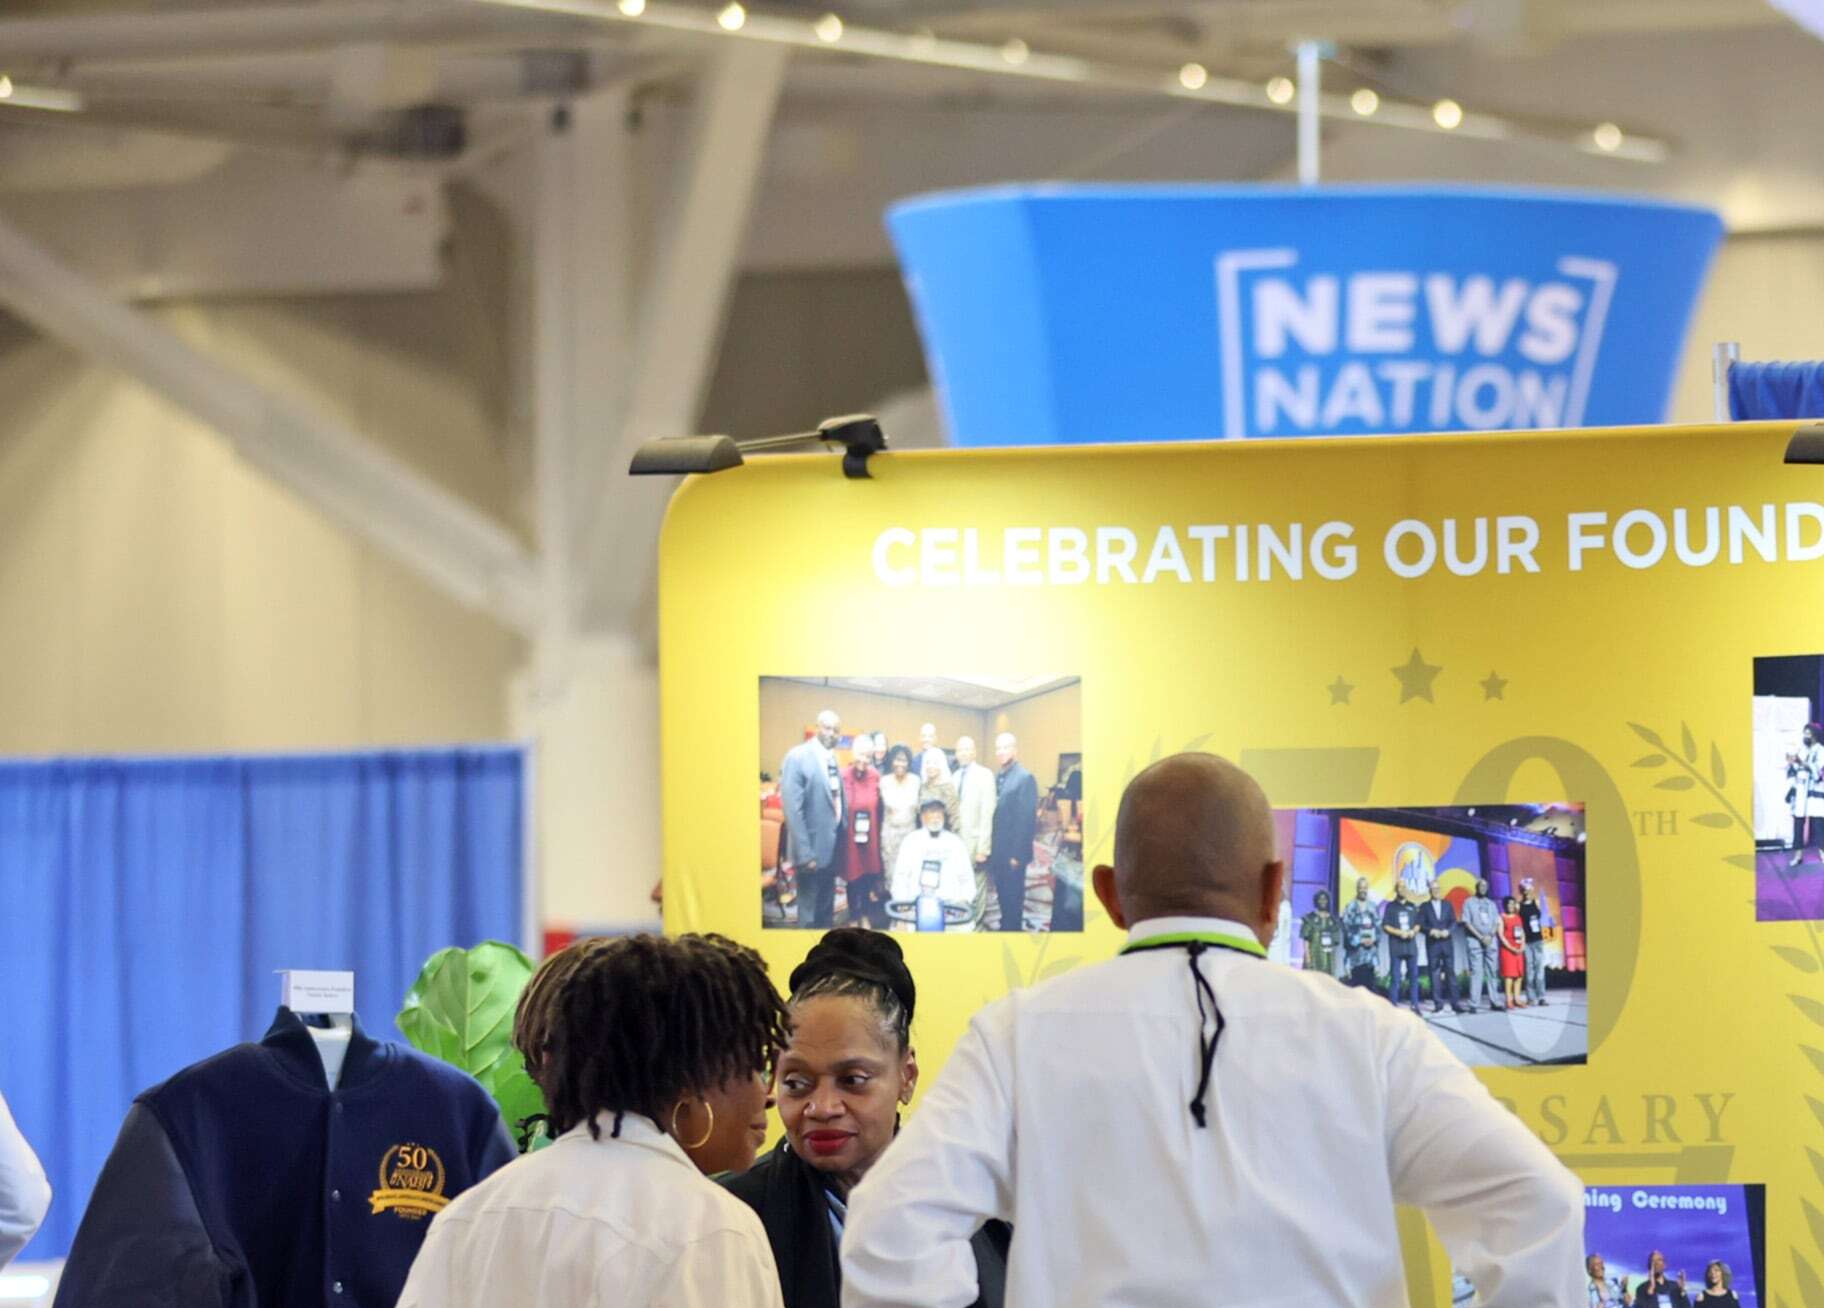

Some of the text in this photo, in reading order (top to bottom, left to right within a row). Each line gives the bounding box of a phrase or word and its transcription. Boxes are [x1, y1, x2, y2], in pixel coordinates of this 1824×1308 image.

[1252, 271, 1583, 364] NEWS
[1254, 361, 1567, 430] NATION
[871, 521, 1357, 586] CELEBRATING
[1384, 515, 1540, 578] OUR
[1634, 810, 1679, 836] TH
[398, 1146, 428, 1170] 50
[1632, 1190, 1727, 1215] Ceremony
